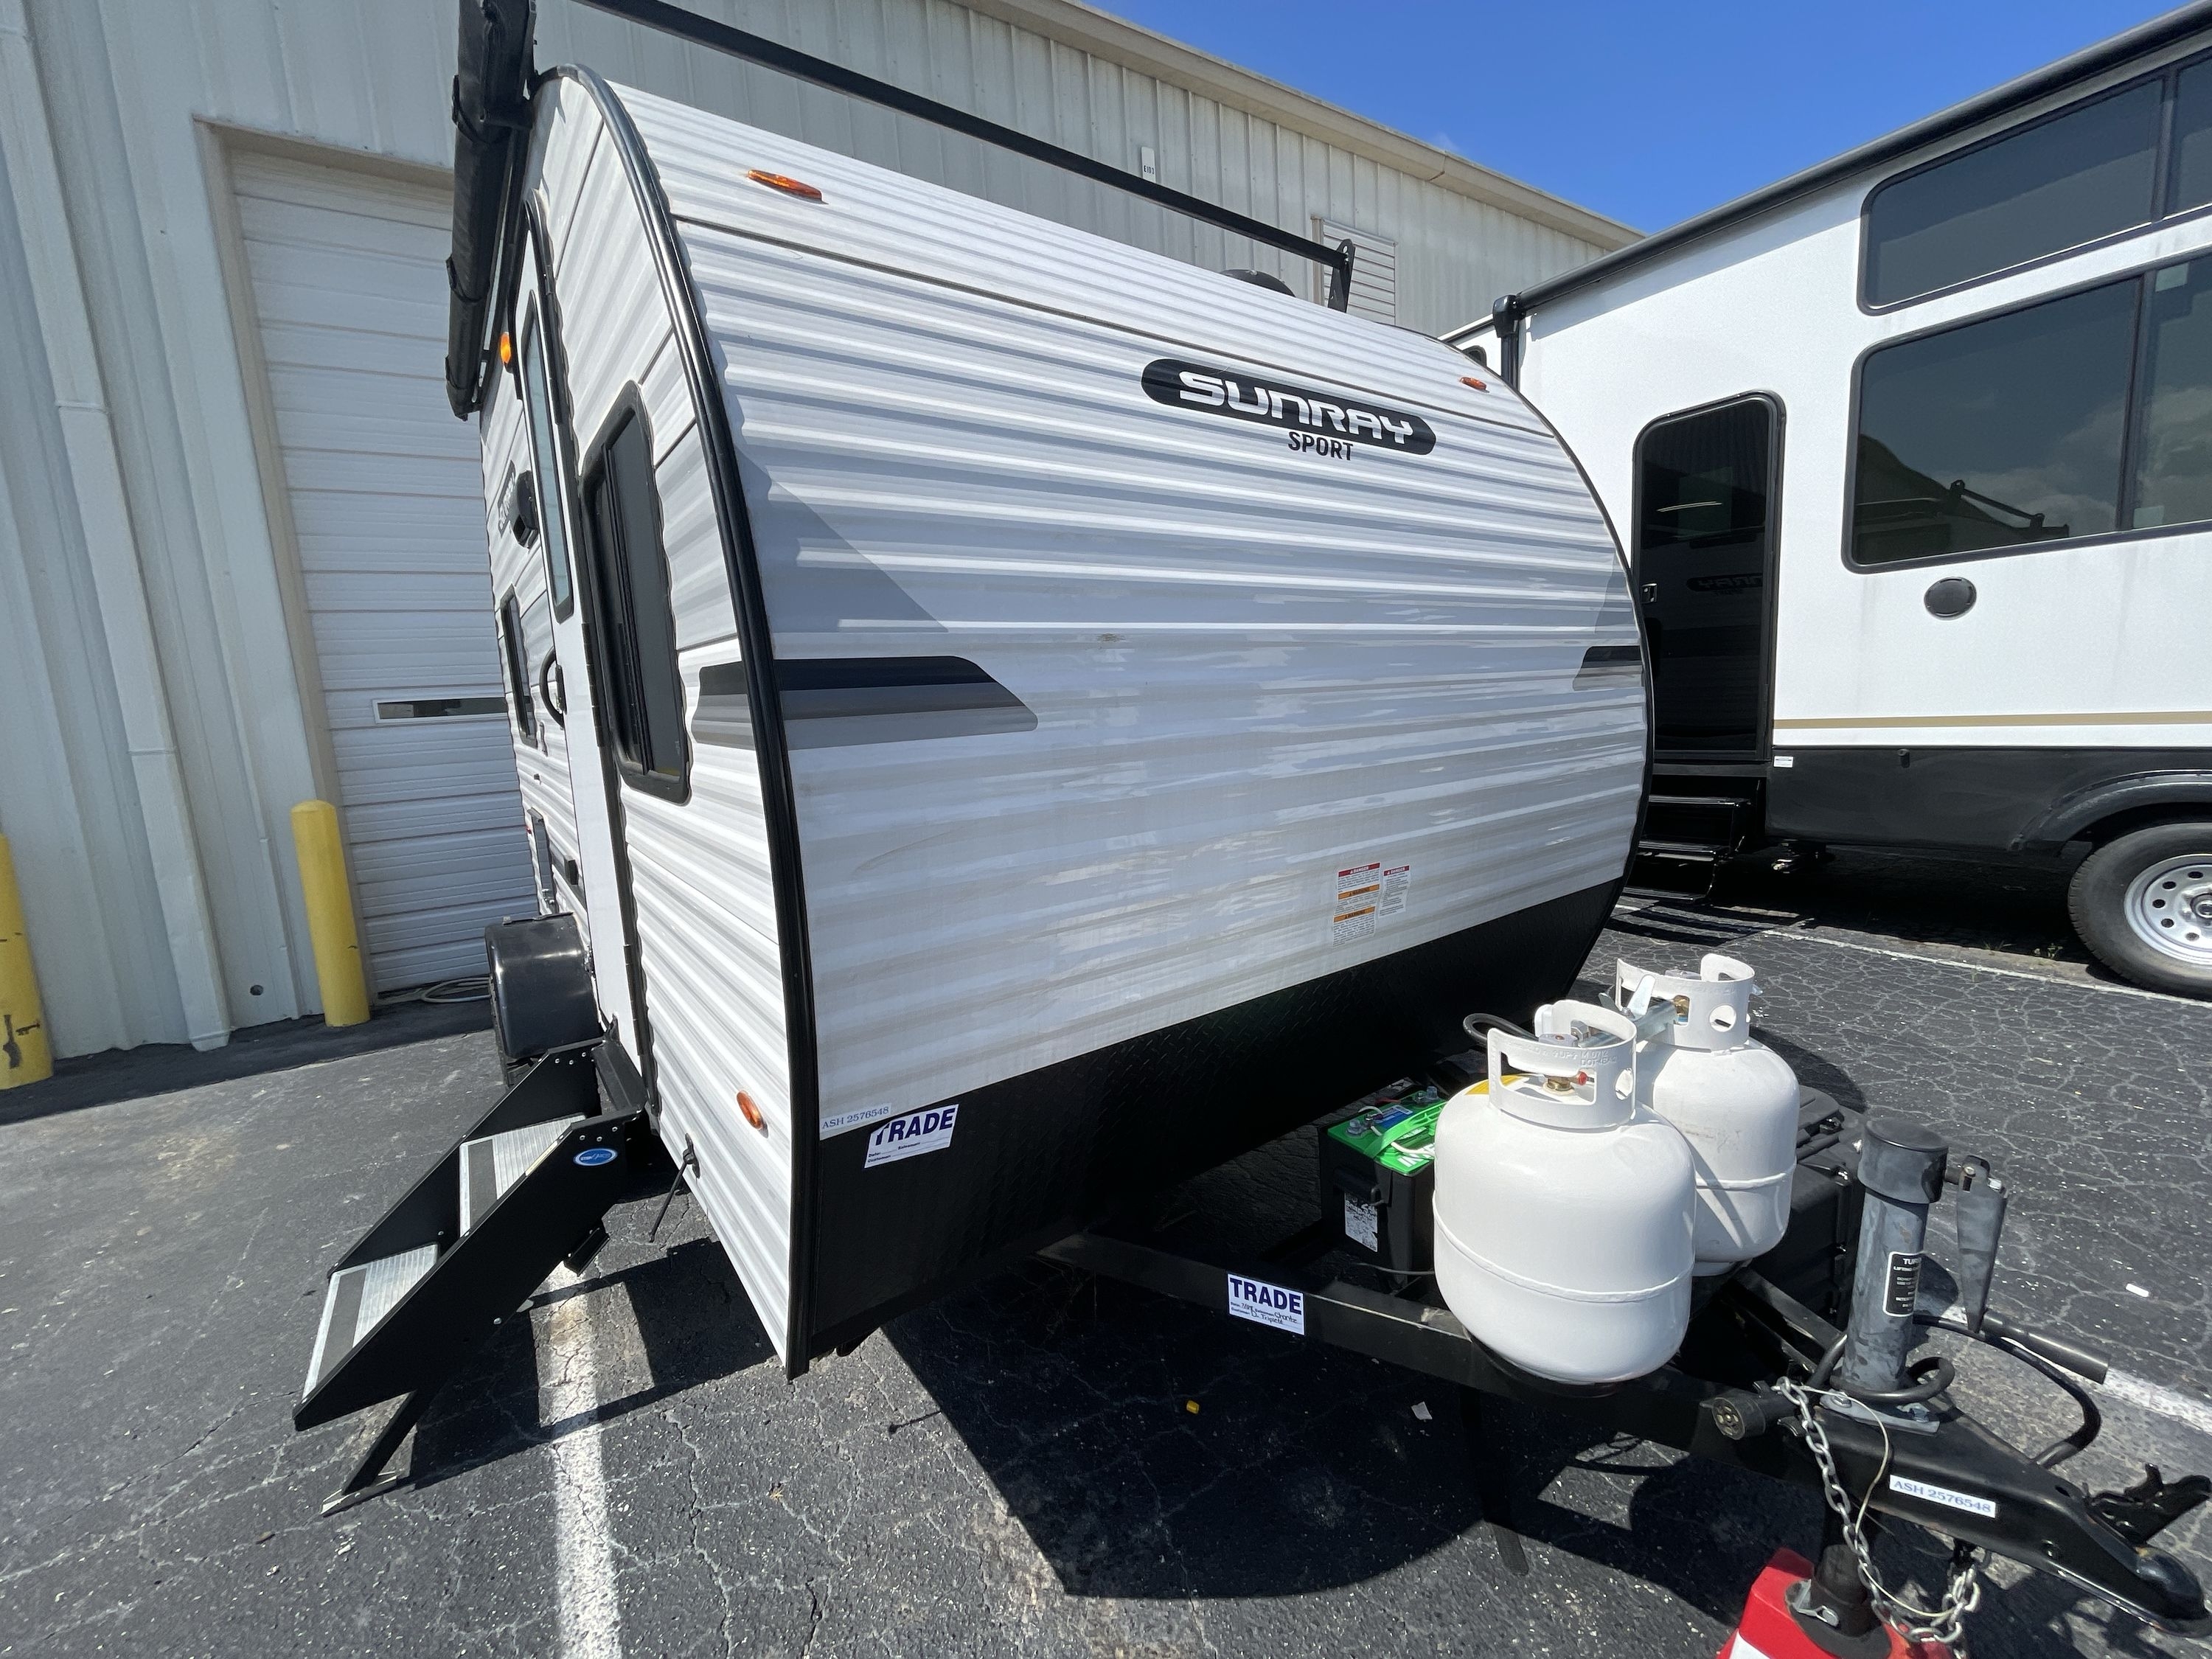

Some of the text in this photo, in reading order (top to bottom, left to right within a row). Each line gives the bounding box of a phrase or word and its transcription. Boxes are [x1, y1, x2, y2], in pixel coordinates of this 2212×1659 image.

[1179, 371, 1413, 445] SUNRAY
[1287, 431, 1354, 461] SPORT
[822, 1107, 889, 1129] ASH 2576548
[875, 1107, 956, 1146] TRADE
[1229, 1277, 1302, 1315] TRADE
[1894, 1481, 1992, 1512] ASH 2576548
